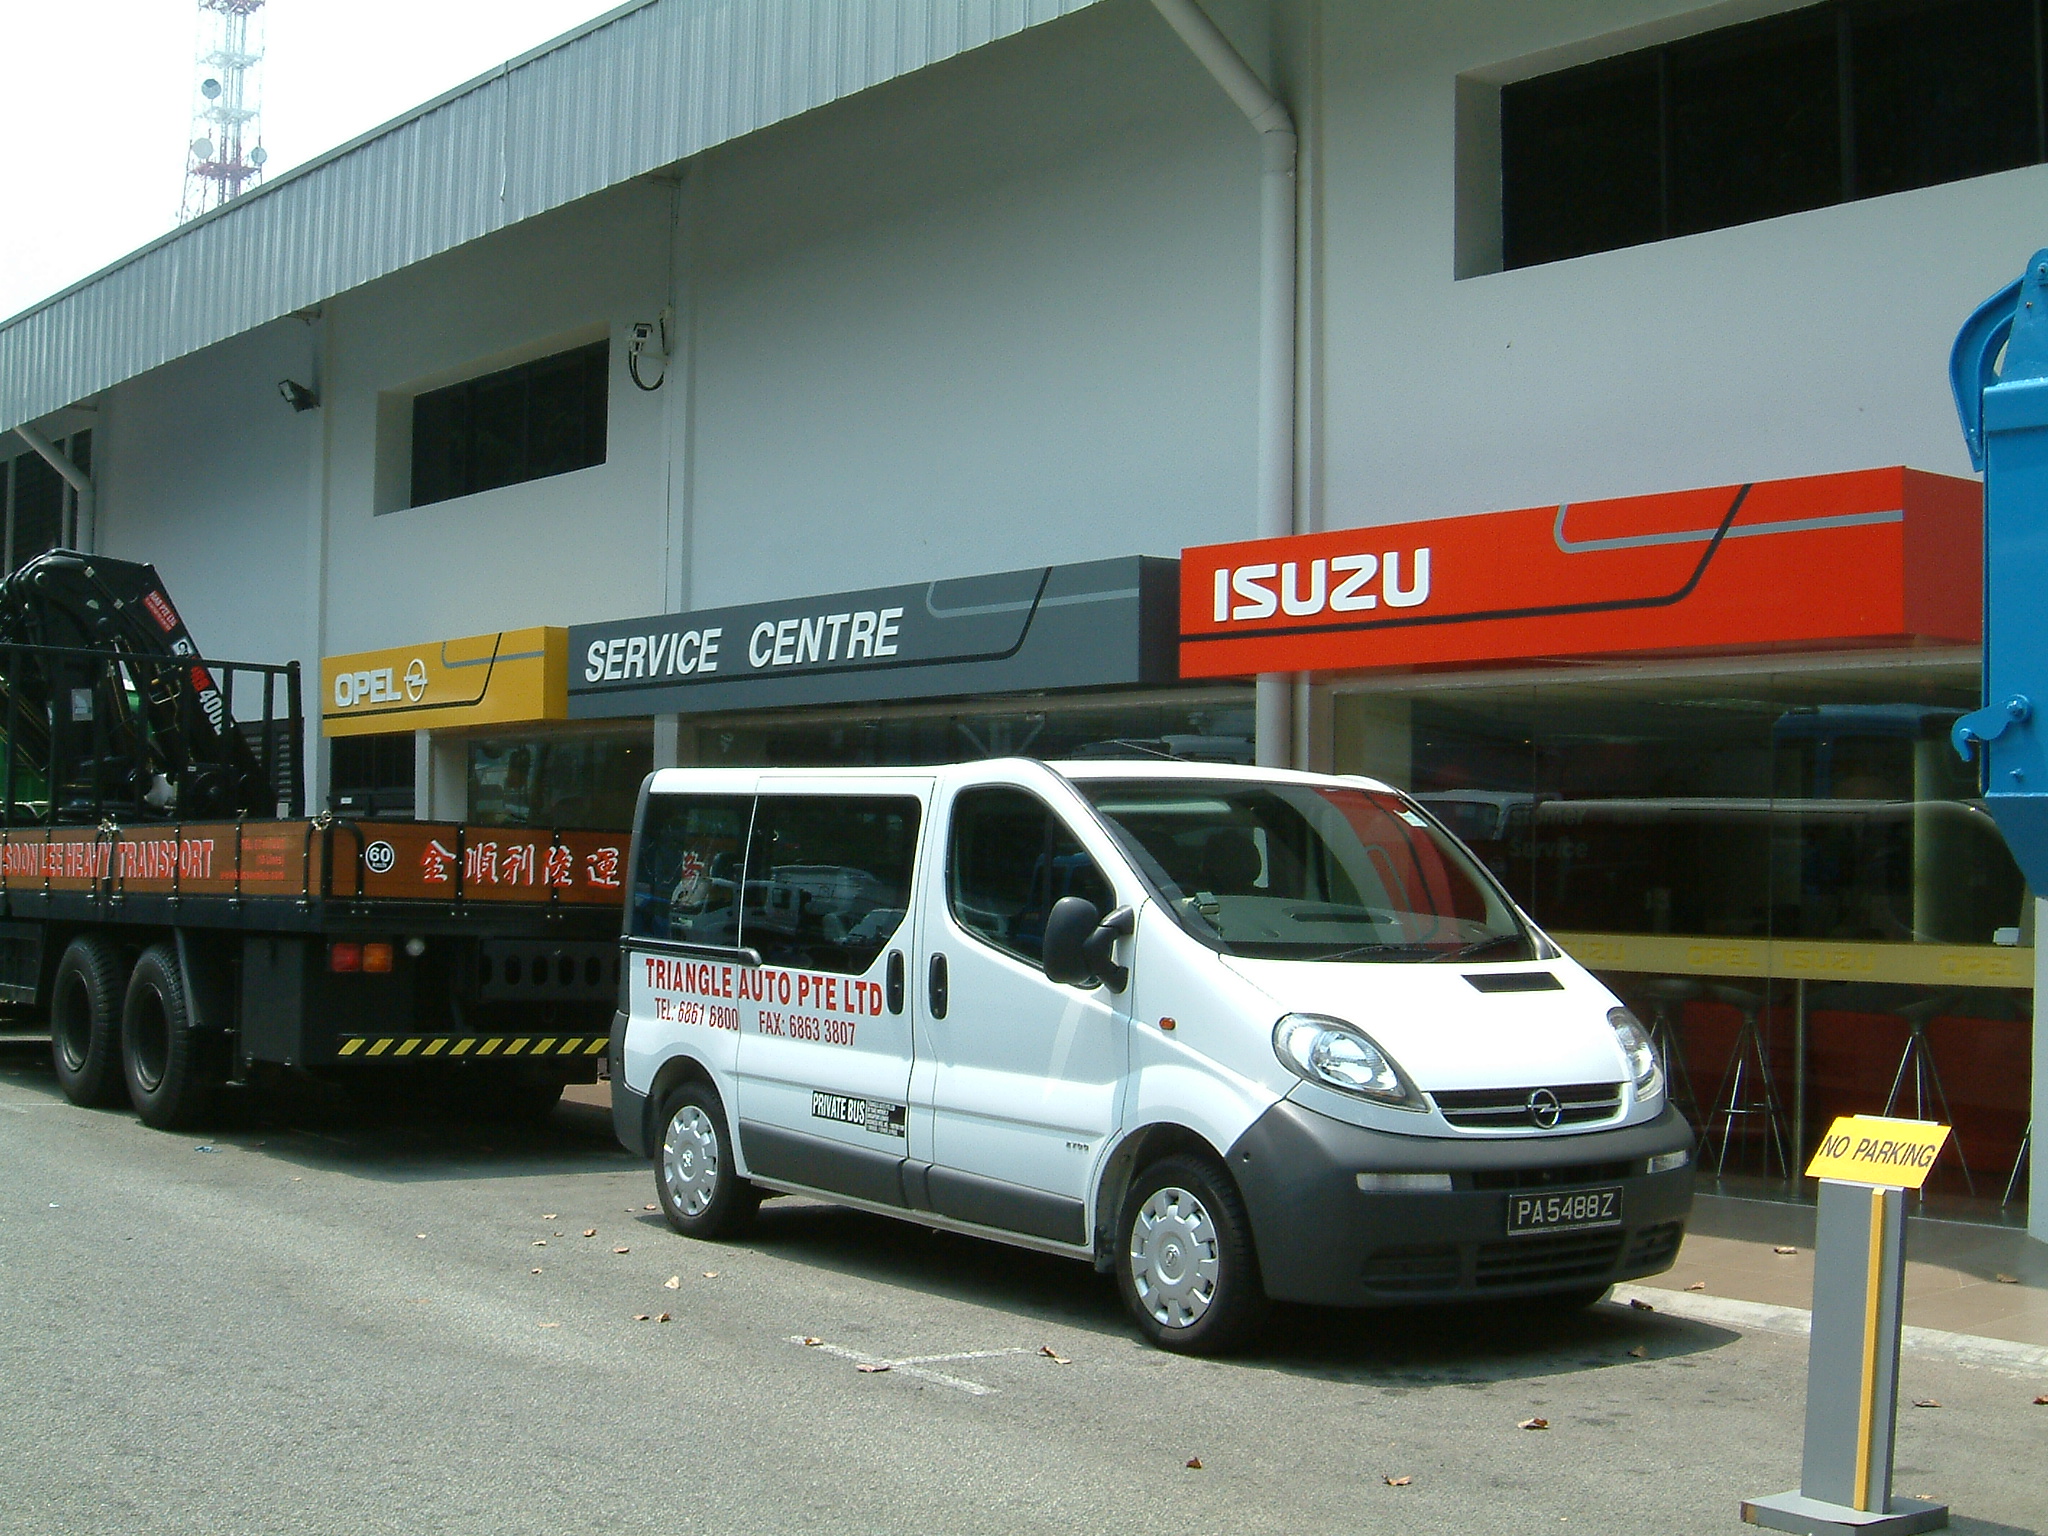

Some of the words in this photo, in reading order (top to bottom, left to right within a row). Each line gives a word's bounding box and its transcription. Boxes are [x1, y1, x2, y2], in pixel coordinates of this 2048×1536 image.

[1213, 547, 1431, 622] ISUZU
[585, 627, 723, 684] SERVICE
[748, 607, 904, 669] CENTRE
[334, 668, 402, 708] OPEL
[65, 841, 112, 879] HEAVY
[117, 838, 214, 879] TRANSPORT
[369, 847, 391, 862] 60
[1687, 944, 1760, 969] OPEL
[1783, 948, 1878, 973] ISUZU
[1937, 953, 2022, 979] OPEL
[645, 957, 733, 999] TRIANGLE
[738, 967, 791, 1006] AUTO
[797, 974, 837, 1012] PTE
[844, 979, 883, 1017] LTD
[655, 997, 676, 1021] TEL:
[677, 1000, 705, 1027] 6861
[708, 1004, 739, 1031] 6800
[759, 1010, 786, 1037] FAX:
[788, 1014, 820, 1042] 6863
[823, 1018, 856, 1047] 3807
[812, 1092, 848, 1120] PRIVATE
[847, 1099, 866, 1125] BUS
[1818, 1134, 1851, 1159] NO
[1851, 1138, 1937, 1168] PARKING
